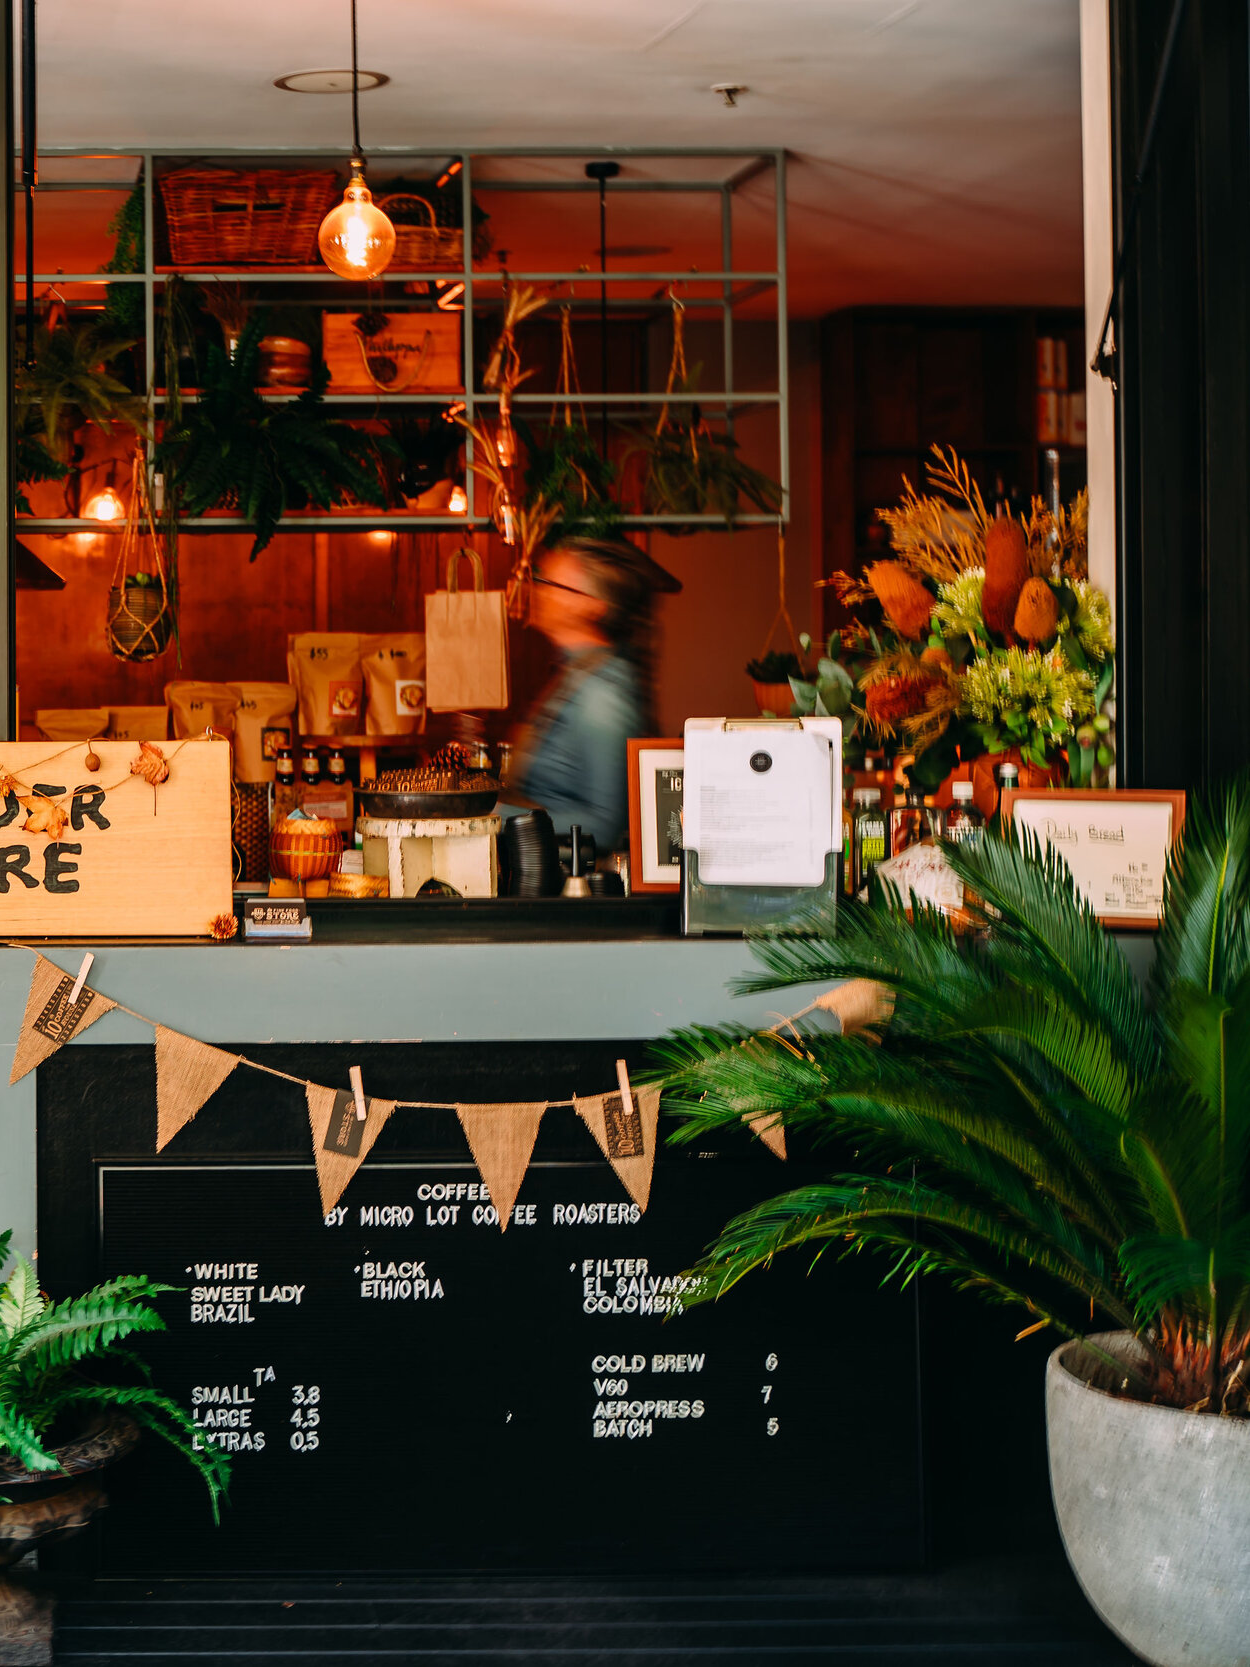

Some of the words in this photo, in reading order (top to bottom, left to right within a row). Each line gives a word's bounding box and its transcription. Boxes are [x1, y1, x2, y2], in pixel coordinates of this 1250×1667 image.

[266, 911, 299, 920] STORE
[45, 1020, 62, 1039] 10
[417, 1183, 490, 1201] COFFEE
[324, 1206, 349, 1227] BY
[360, 1206, 414, 1227] MICRO
[425, 1205, 461, 1226] LOT
[553, 1203, 641, 1226] ROASTERS
[194, 1263, 259, 1280] WHITE
[362, 1261, 426, 1280] BLACK
[582, 1258, 648, 1277] FILTER
[190, 1285, 254, 1303] SWEET
[259, 1284, 305, 1305] LADY
[360, 1279, 444, 1301] ETHIOPIA
[583, 1276, 607, 1297] EL
[190, 1303, 255, 1324] BRAZIL
[591, 1355, 646, 1373] COLD
[651, 1353, 705, 1373] BREW
[765, 1352, 778, 1371] 6
[191, 1384, 255, 1405] SMALL
[593, 1378, 629, 1396] V60
[761, 1385, 773, 1404] 7
[192, 1407, 252, 1428] LARGE
[592, 1400, 705, 1419] AEROPRESS
[593, 1419, 653, 1440] BATCH
[766, 1417, 779, 1436] 5
